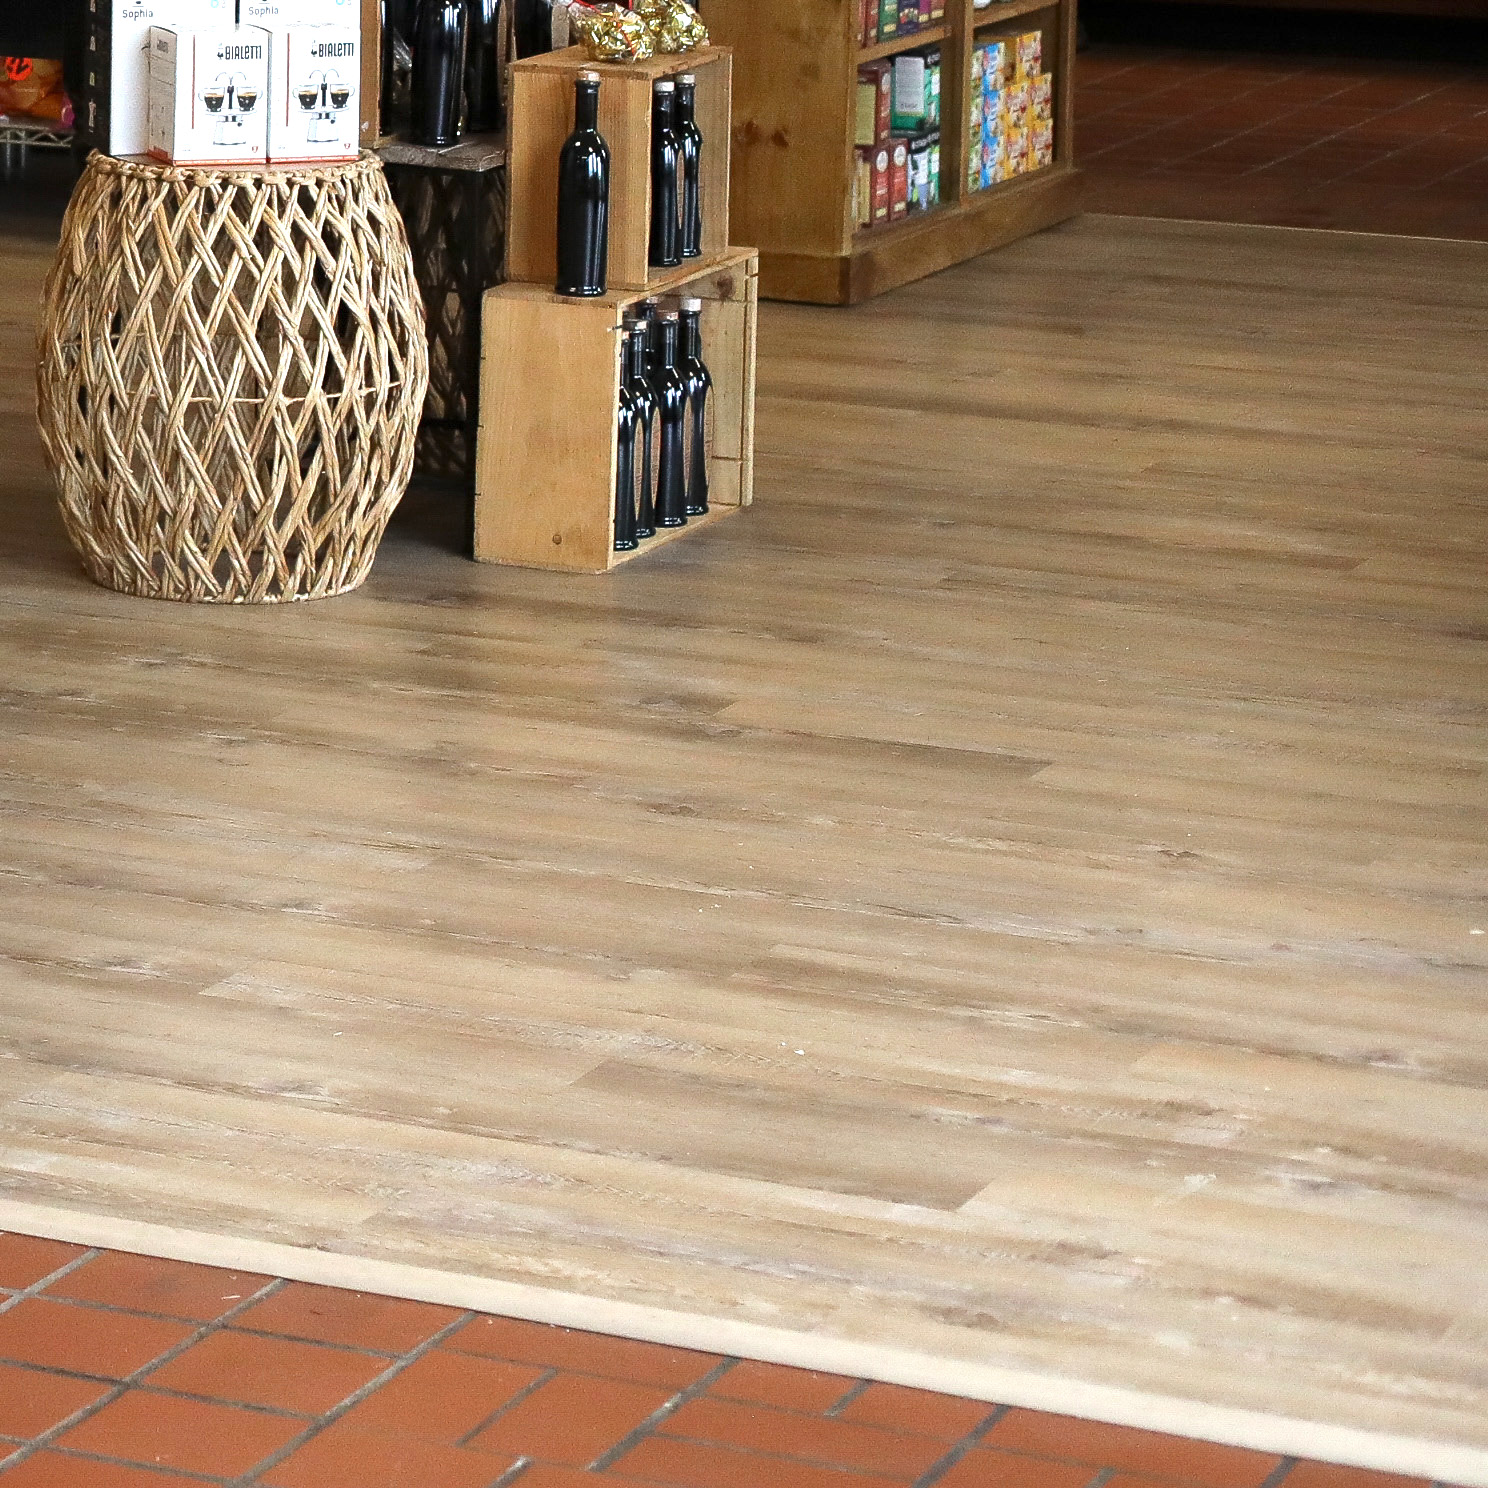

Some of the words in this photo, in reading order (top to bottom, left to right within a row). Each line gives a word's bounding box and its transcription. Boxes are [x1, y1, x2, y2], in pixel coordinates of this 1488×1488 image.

[122, 8, 154, 21] Sophia
[248, 6, 279, 18] Sophia
[224, 44, 262, 61] BIALETTI
[318, 42, 355, 58] BIALETTI
